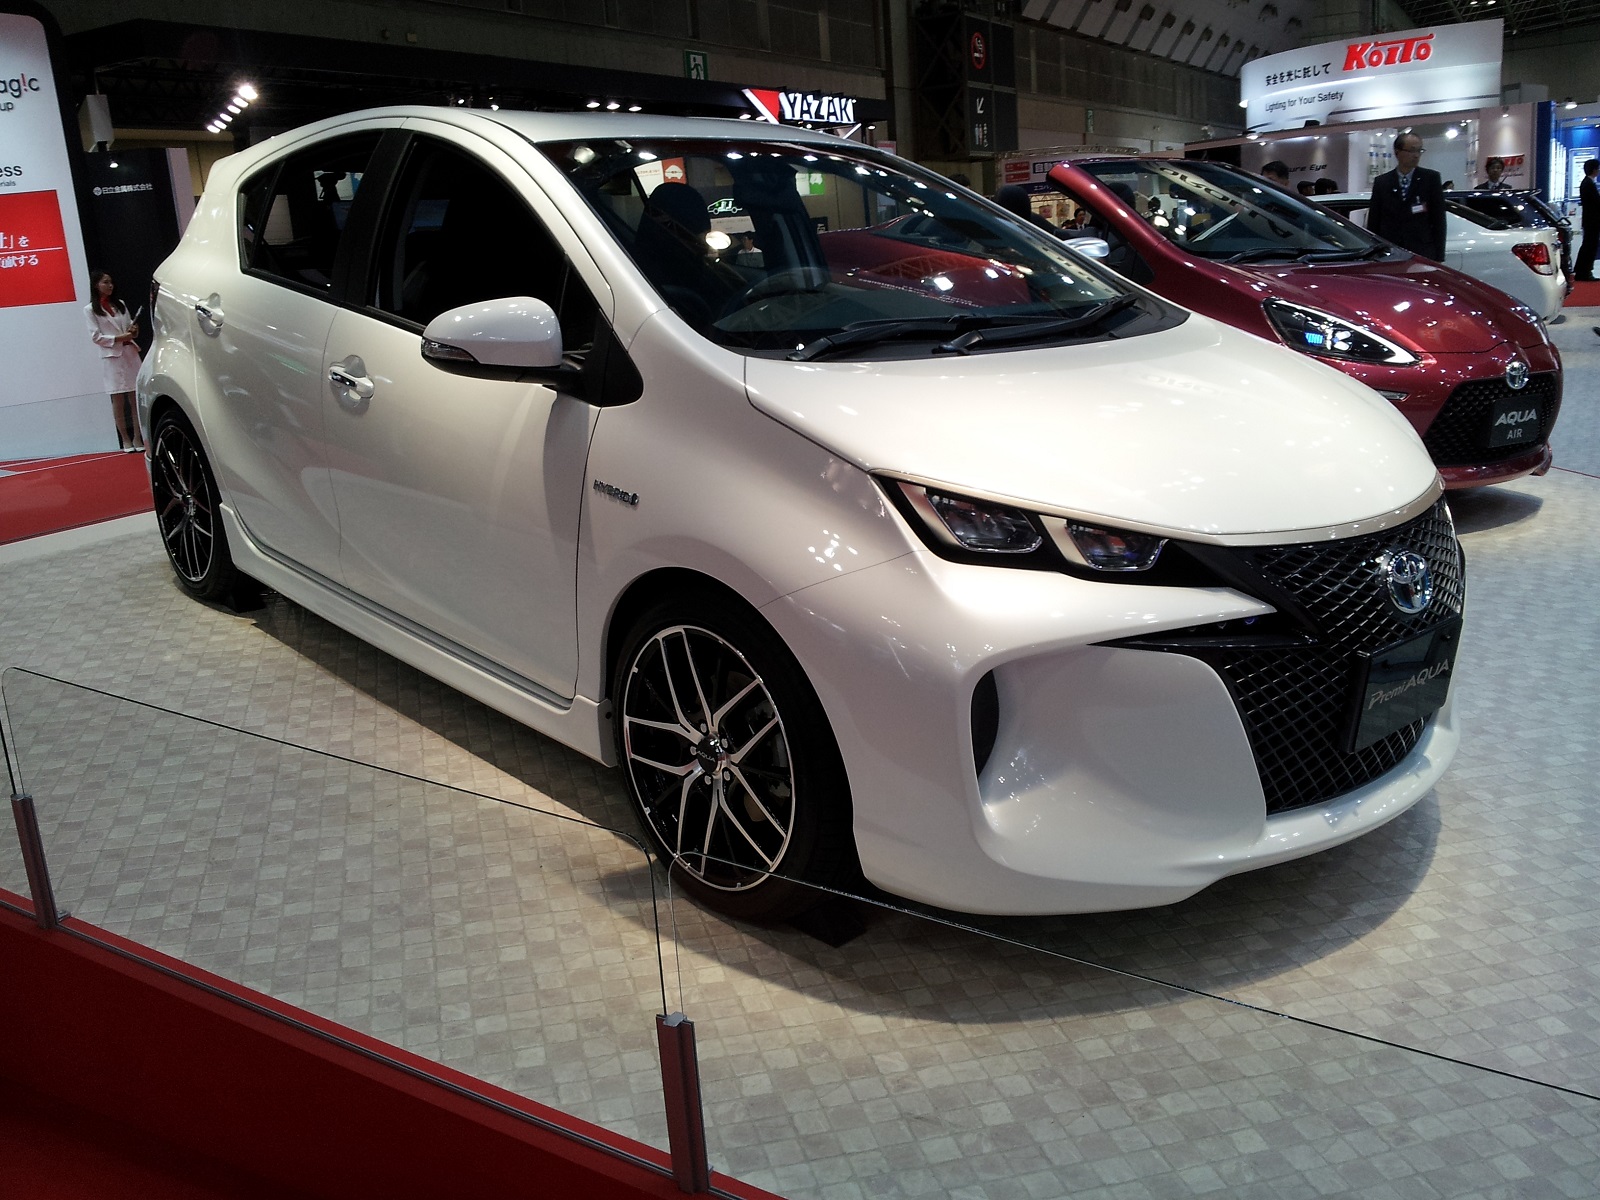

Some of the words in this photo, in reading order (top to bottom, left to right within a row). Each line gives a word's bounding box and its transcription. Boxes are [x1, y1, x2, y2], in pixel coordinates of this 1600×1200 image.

[1266, 63, 1331, 86] 安全を光に託して
[1265, 101, 1287, 113] Lighting
[1288, 99, 1297, 108] for
[1299, 95, 1315, 106] Your
[1317, 90, 1344, 103] Safety
[1494, 408, 1537, 426] AQUA
[1506, 428, 1523, 440] AIR
[696, 750, 716, 763] AQUA
